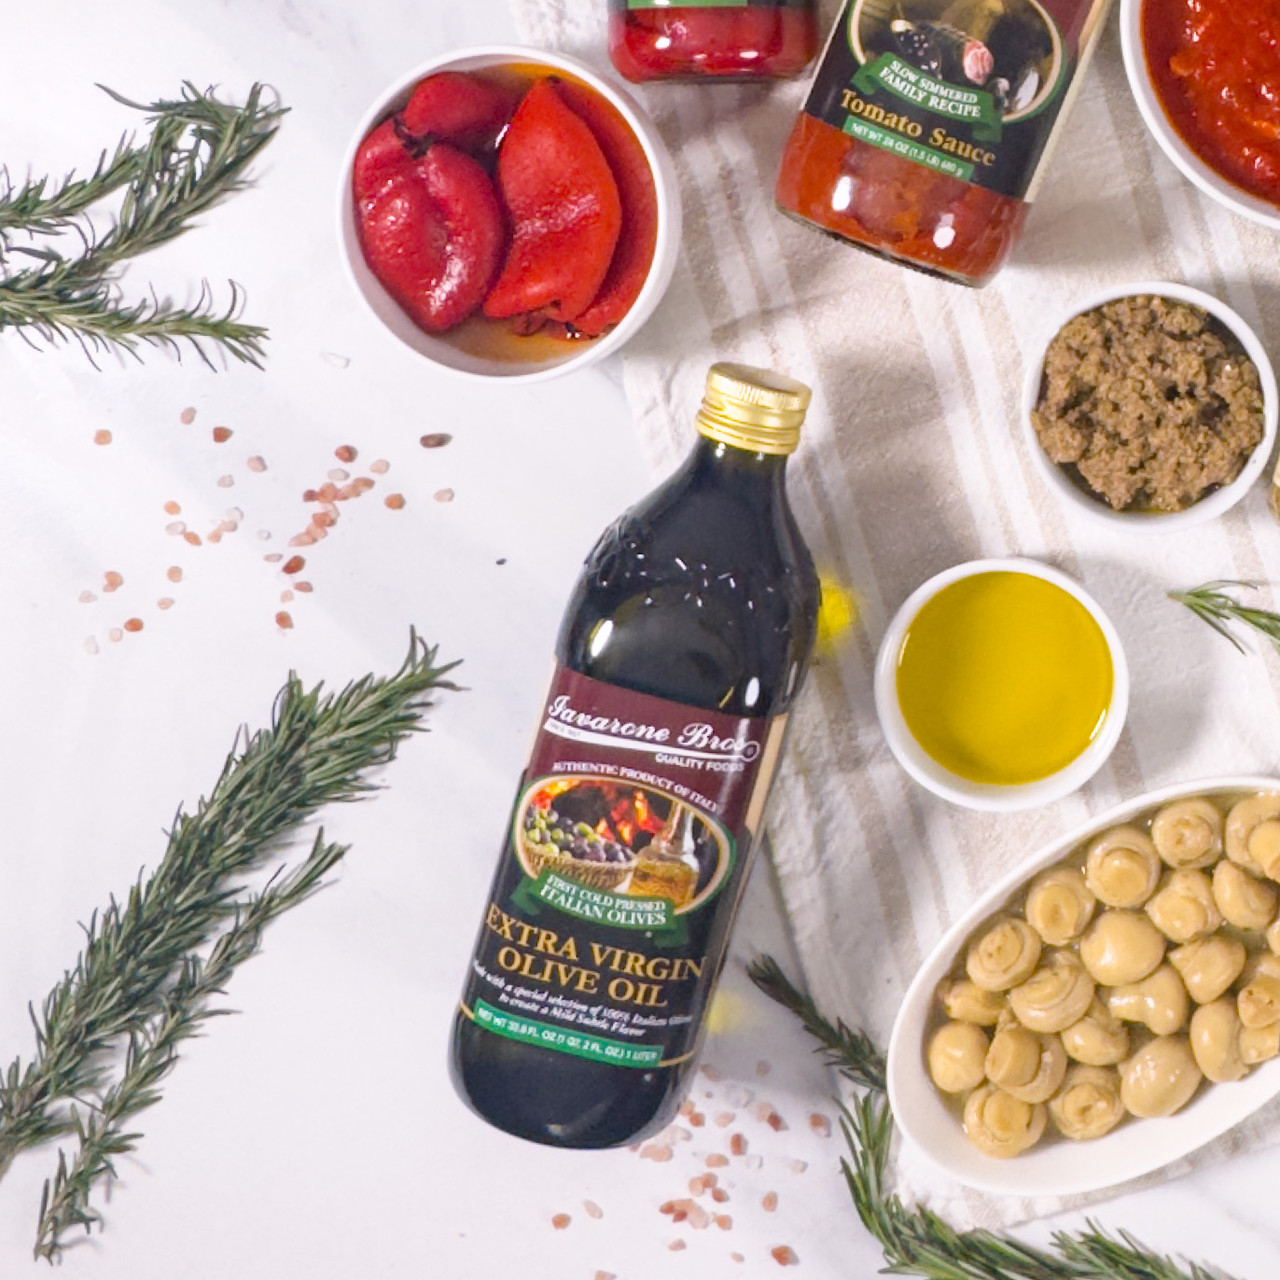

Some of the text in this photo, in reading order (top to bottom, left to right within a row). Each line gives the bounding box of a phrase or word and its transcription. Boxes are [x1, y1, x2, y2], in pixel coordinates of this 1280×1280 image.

[879, 66, 981, 118] FAMILY RECIPE
[890, 60, 978, 104] SLOW SIMMERED
[840, 88, 997, 166] Tomato Sauce
[551, 760, 618, 776] AUTHENTIC
[618, 766, 674, 791] PRODUCT
[673, 782, 691, 797] OF
[655, 752, 745, 772] QUALITY FOODS
[539, 884, 667, 926] ITALIAN OLIVES
[546, 874, 666, 912] FIRST COLD PRESSED
[486, 902, 707, 981] EXTRA VIRGIN
[497, 946, 669, 1008] OLIVE OIL
